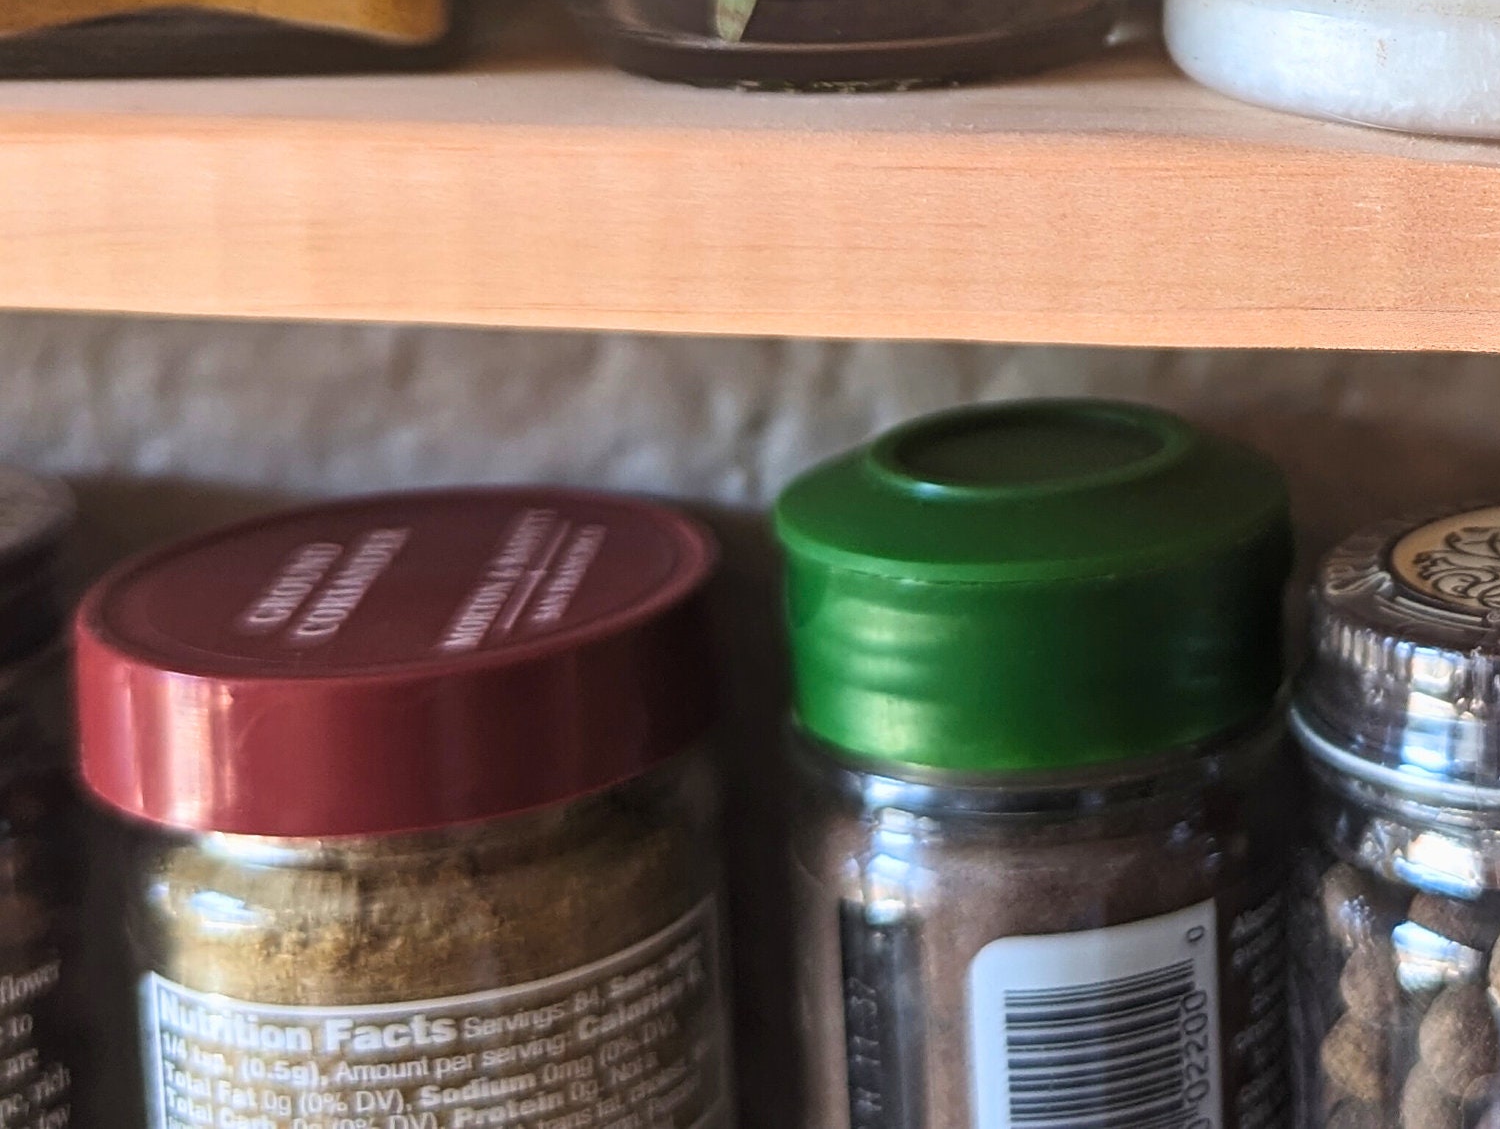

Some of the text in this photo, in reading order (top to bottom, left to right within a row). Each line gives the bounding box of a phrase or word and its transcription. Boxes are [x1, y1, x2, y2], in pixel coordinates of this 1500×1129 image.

[1186, 925, 1205, 943] 0
[160, 988, 312, 1052] Nutrition
[325, 1013, 458, 1052] Facts
[1182, 990, 1210, 1103] 02200
[335, 1055, 429, 1082] Amount
[432, 1053, 475, 1081] per
[263, 1089, 292, 1116] 0g
[300, 1090, 349, 1115] (0%
[418, 1074, 537, 1109] Sodium
[454, 1091, 565, 1129] Protein
